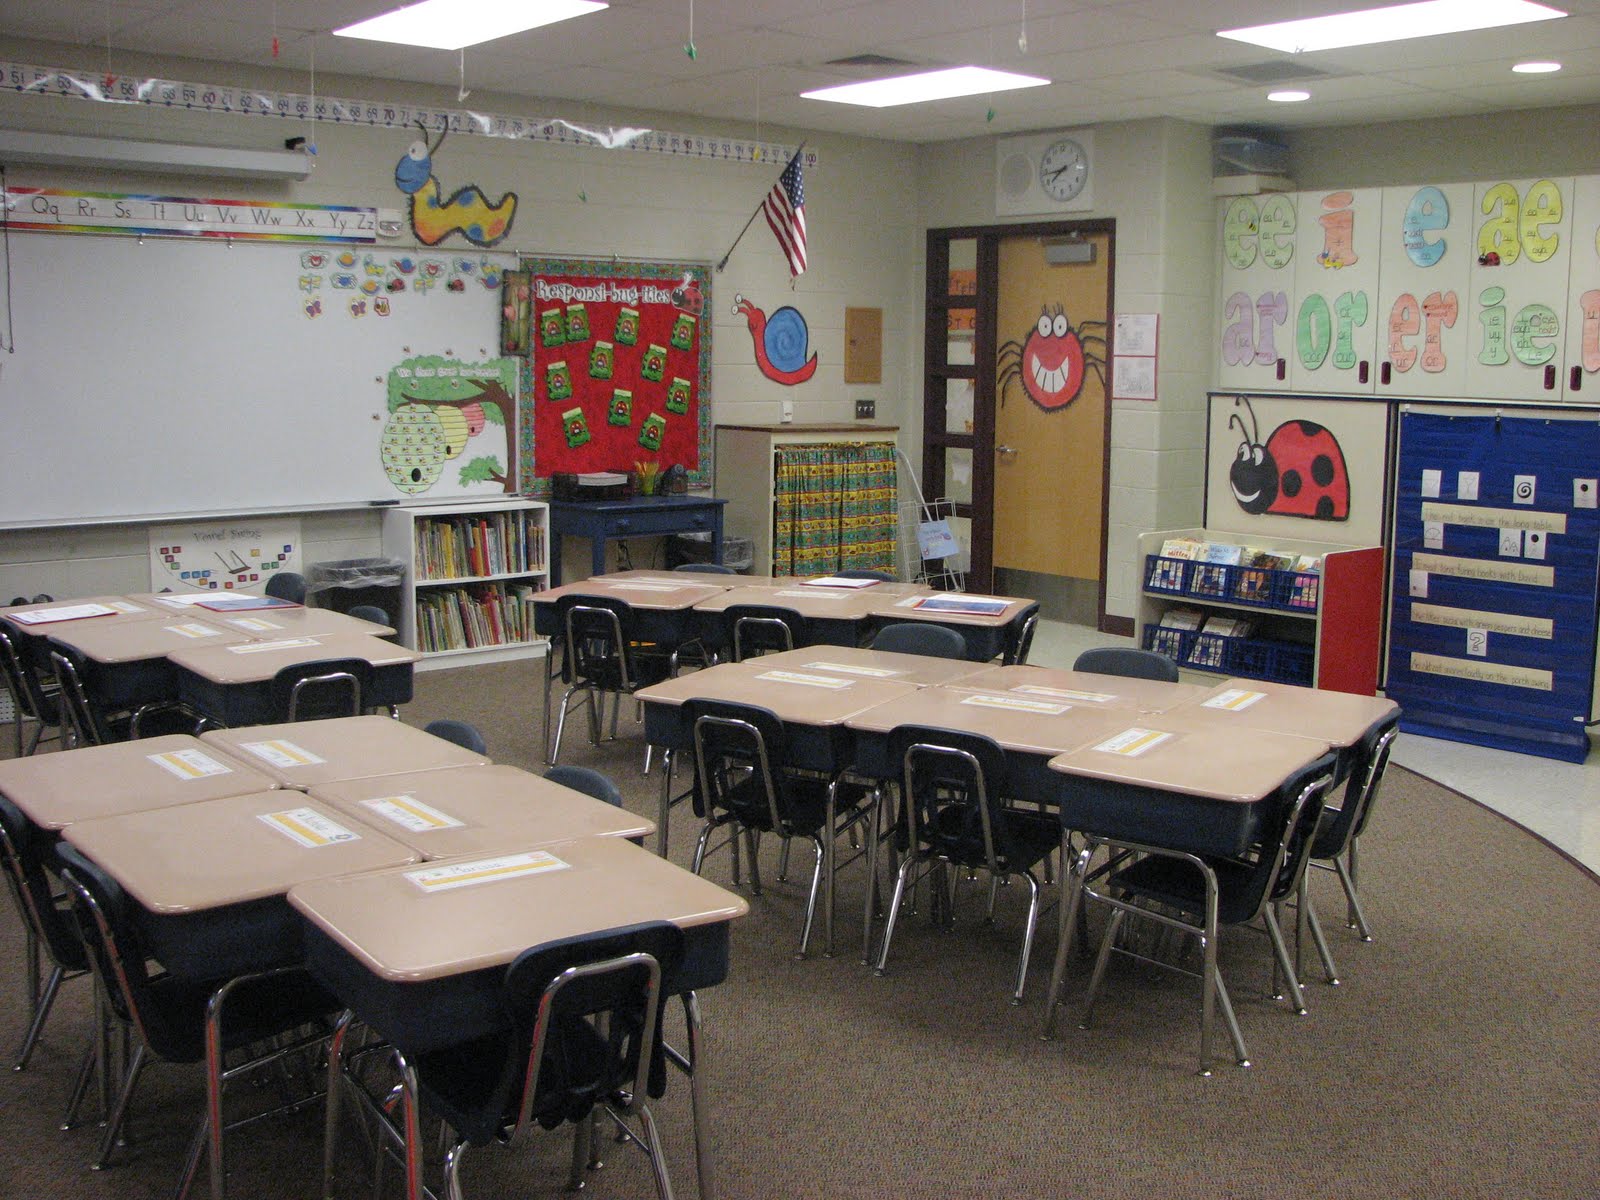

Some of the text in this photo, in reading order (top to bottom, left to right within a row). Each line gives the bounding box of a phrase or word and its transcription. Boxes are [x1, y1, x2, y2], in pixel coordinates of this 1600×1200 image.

[11, 71, 24, 84] 51
[57, 75, 72, 90] 53
[183, 89, 196, 102] 59
[203, 91, 216, 104] 60
[240, 95, 252, 108] 62
[277, 99, 289, 111] 64
[350, 106, 361, 118] 68
[367, 107, 378, 119] 69
[384, 109, 395, 121] 70
[400, 111, 410, 122] 71
[416, 111, 428, 124] 72
[543, 125, 554, 136] 80
[683, 139, 693, 150] 90
[805, 152, 817, 164] 100
[31, 196, 62, 223] Qq
[78, 199, 97, 217] Rr
[115, 201, 131, 218] Ss
[151, 203, 166, 220] Tt
[184, 205, 205, 222] Uu
[217, 207, 237, 224] Vv
[251, 208, 282, 226] Ww
[296, 210, 315, 228] Xx
[329, 212, 347, 234] Yy
[357, 214, 374, 230] Zz
[1223, 194, 1296, 270] ee
[1318, 191, 1359, 269] i
[1403, 185, 1449, 268] e
[536, 279, 671, 306] Responsi-bug-ities
[1223, 291, 1288, 366] ar
[1296, 290, 1369, 370] or
[1389, 290, 1458, 373] er
[1478, 286, 1560, 367] ie
